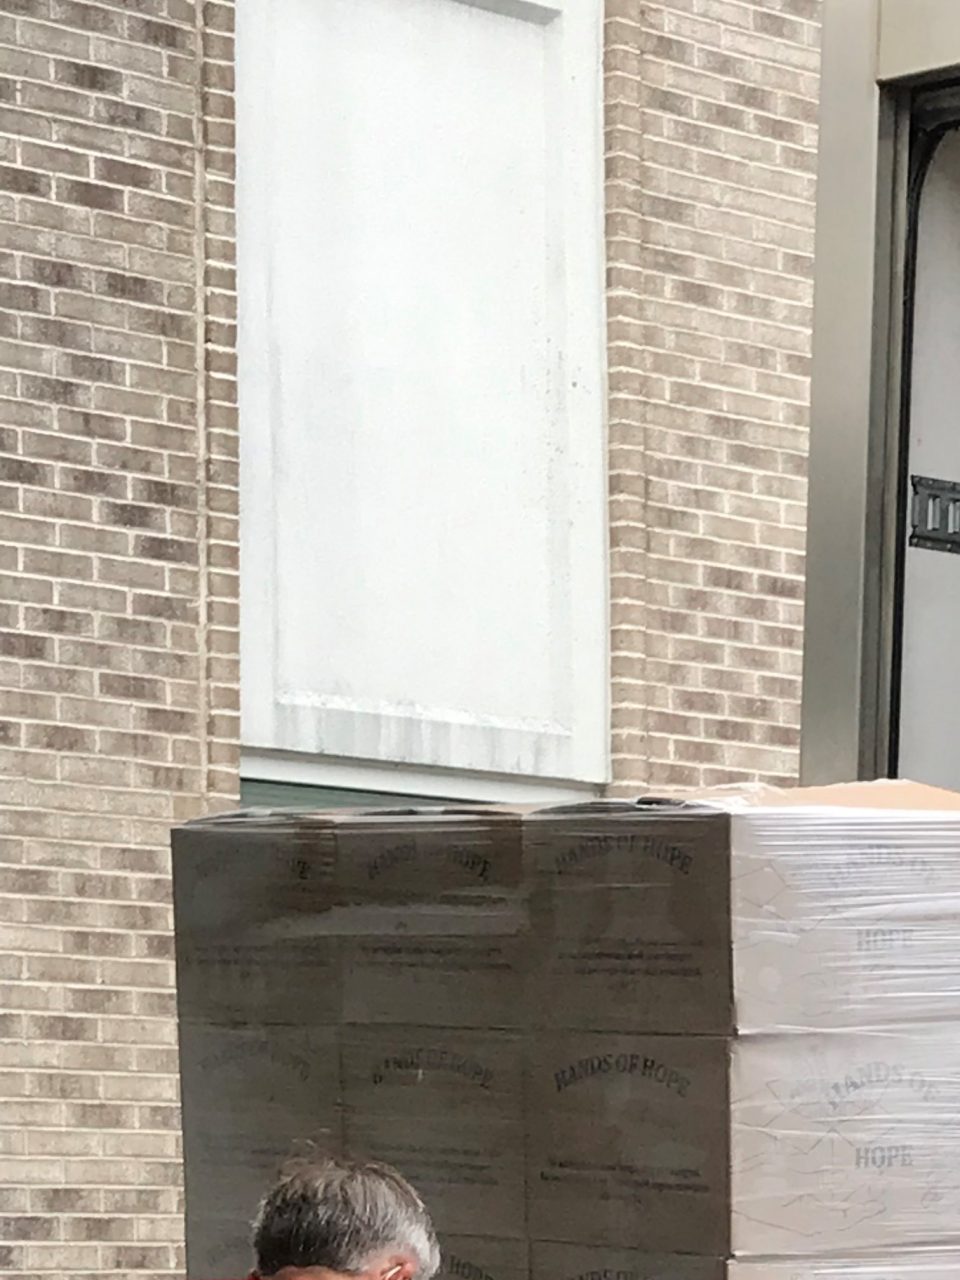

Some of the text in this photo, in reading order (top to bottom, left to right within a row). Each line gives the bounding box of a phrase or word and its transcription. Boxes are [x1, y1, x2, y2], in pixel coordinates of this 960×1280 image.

[856, 929, 914, 951] HOPE
[554, 1053, 613, 1092] HANDS
[642, 1058, 691, 1098] HOPE
[855, 1144, 914, 1169] HOPE
